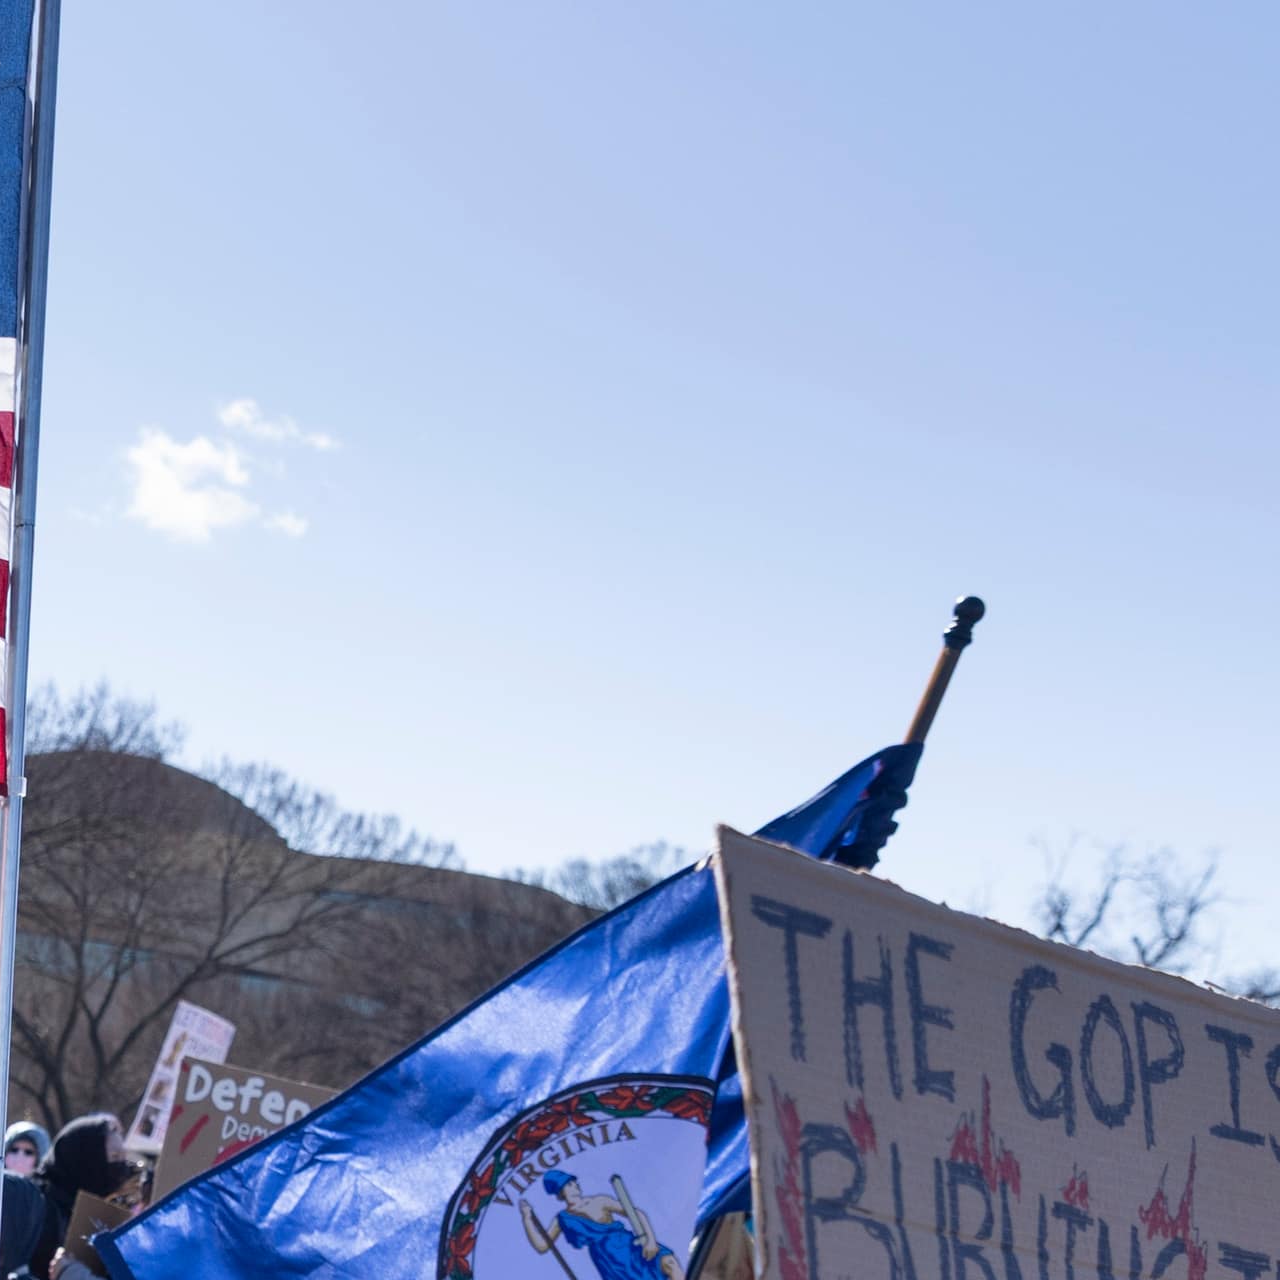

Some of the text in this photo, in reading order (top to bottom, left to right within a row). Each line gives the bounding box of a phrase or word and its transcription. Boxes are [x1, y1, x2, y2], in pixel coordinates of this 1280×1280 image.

[750, 894, 957, 1102] THE
[1009, 964, 1186, 1151] GOP
[494, 1121, 636, 1208] VIRGINIA
